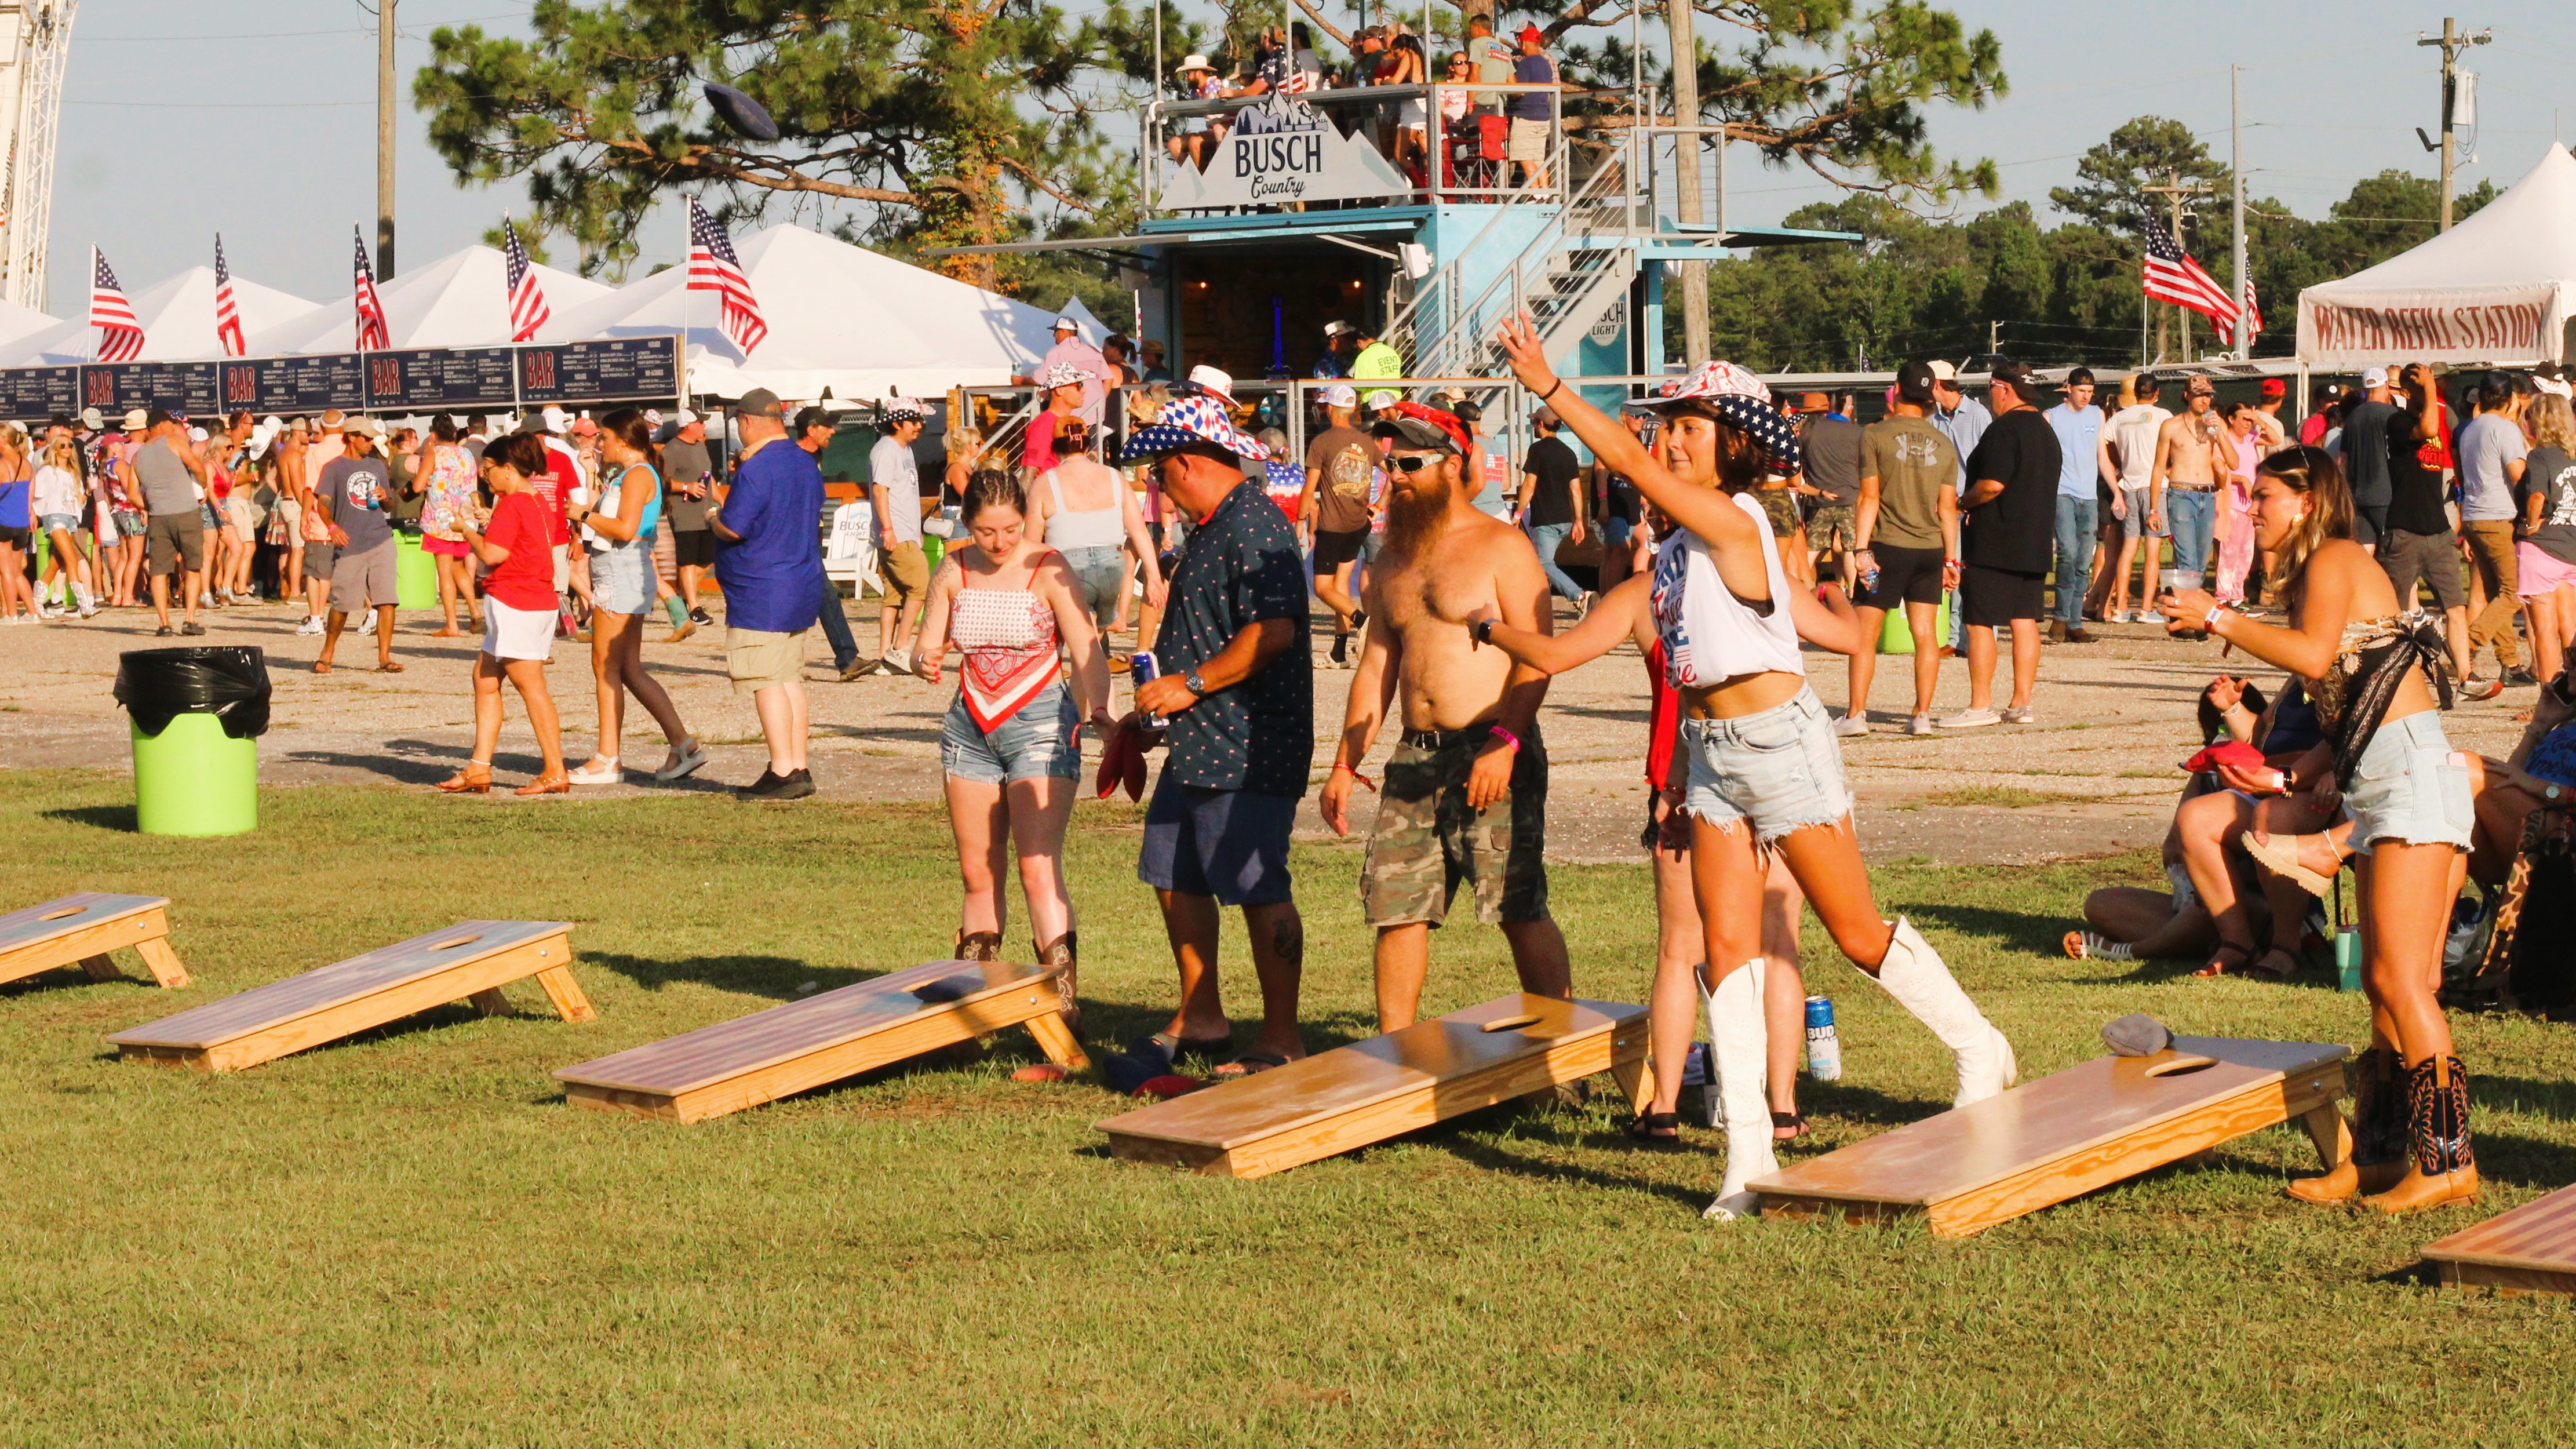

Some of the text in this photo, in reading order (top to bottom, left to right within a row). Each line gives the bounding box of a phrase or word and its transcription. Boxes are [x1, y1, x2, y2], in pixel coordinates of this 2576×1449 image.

[1235, 134, 1322, 177] BUSCH
[1251, 175, 1306, 199] Country
[1593, 325, 1616, 335] LIGHT
[2314, 302, 2544, 351] WATER REFILL STATION
[526, 352, 555, 389] BAR
[1378, 356, 1398, 367] EVENT
[88, 371, 114, 405] BAR
[228, 366, 256, 402] BAR
[372, 359, 400, 396] BAR
[348, 473, 365, 493] WOODEN
[840, 521, 869, 531] BUSC
[1807, 1025, 1835, 1039] BUD
